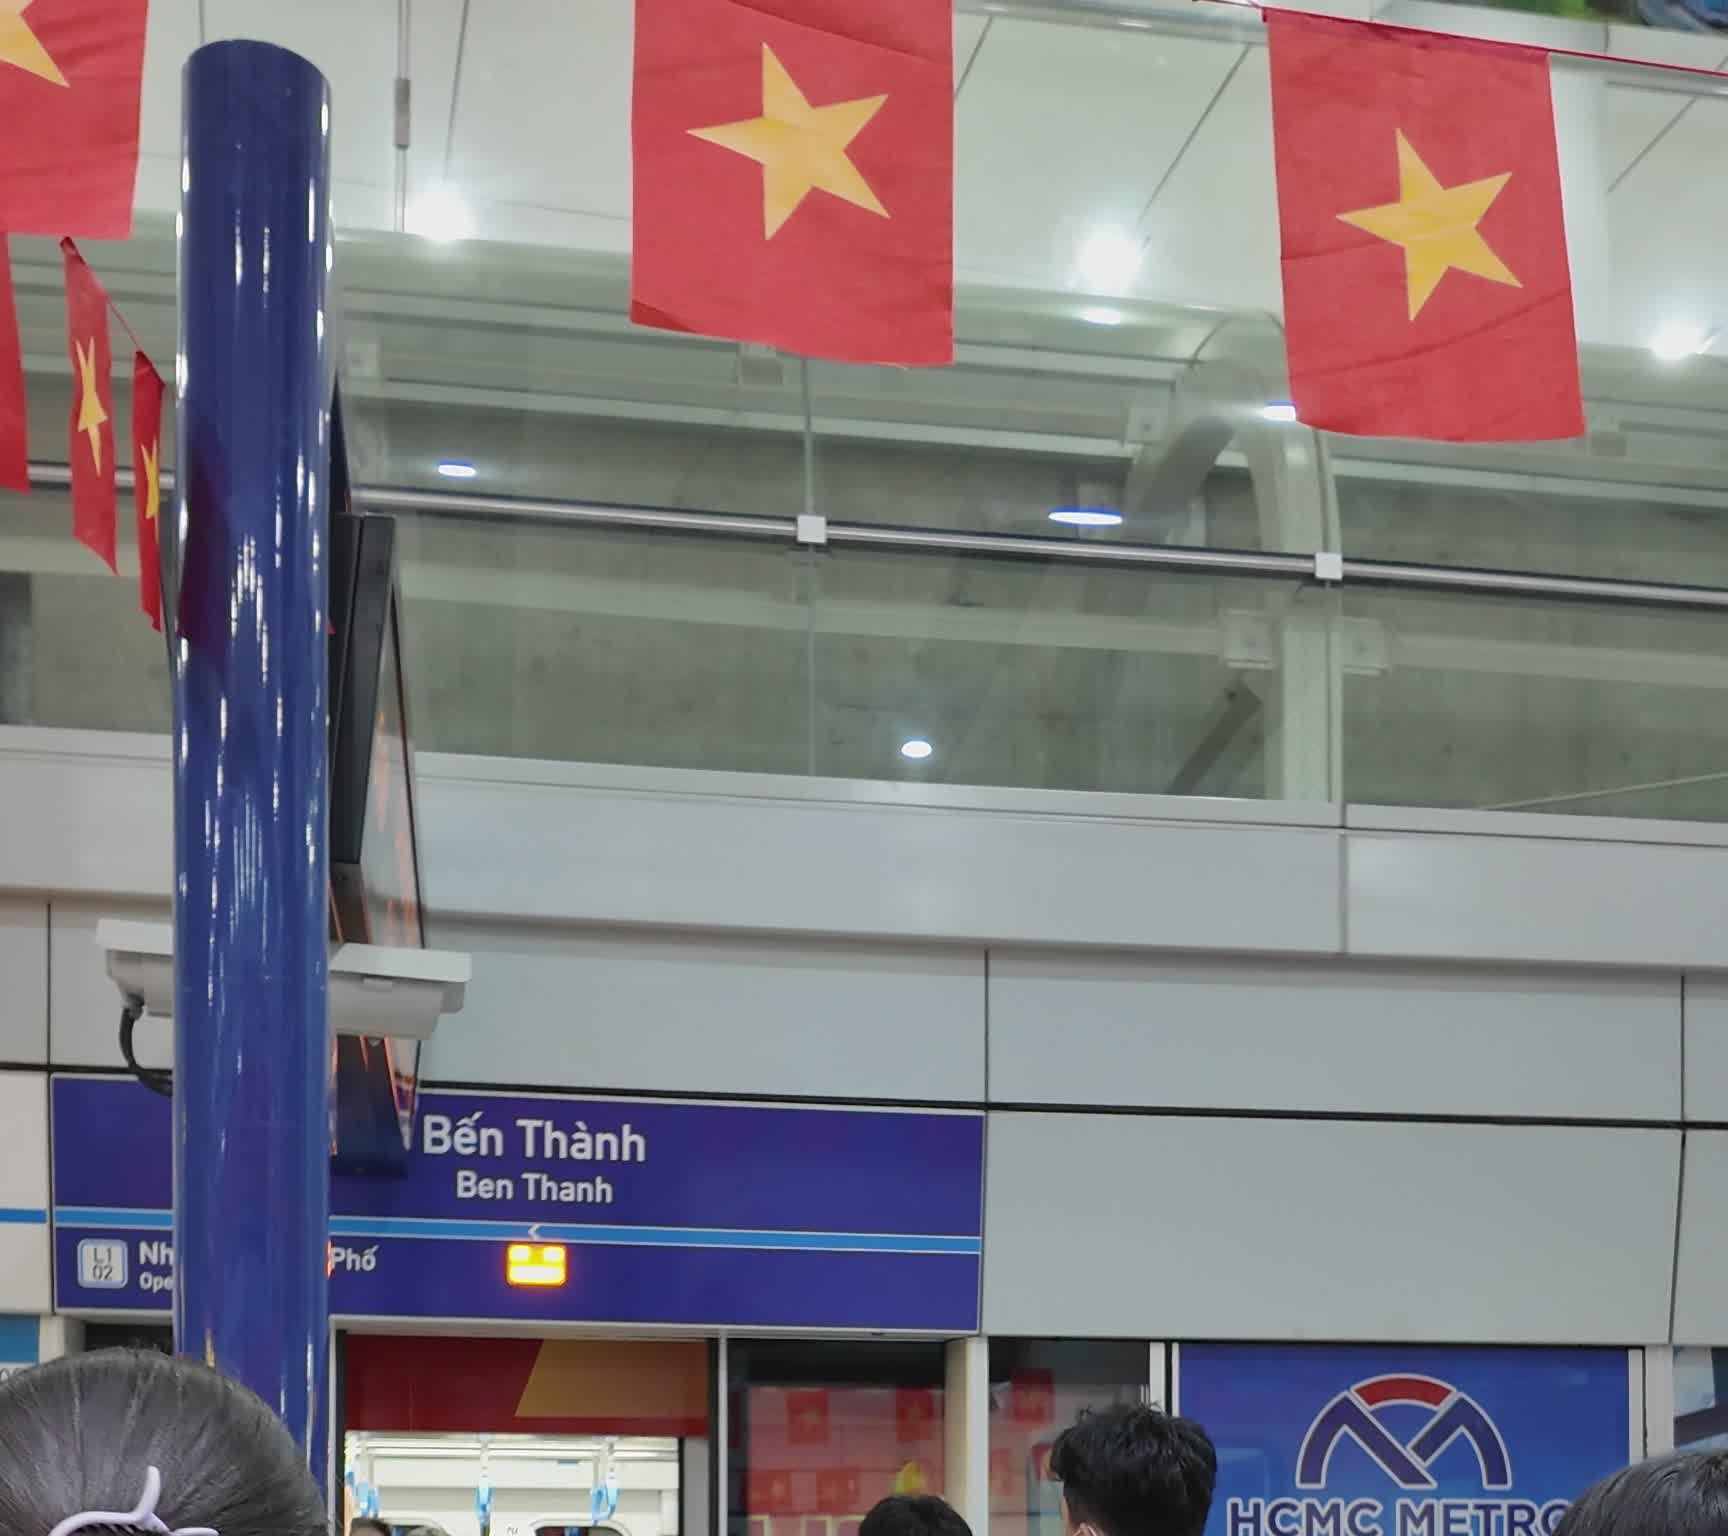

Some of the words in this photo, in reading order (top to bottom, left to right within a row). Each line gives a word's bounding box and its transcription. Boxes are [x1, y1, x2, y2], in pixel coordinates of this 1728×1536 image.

[423, 1111, 504, 1157] Bến
[516, 1119, 646, 1162] Thành
[456, 1170, 514, 1200] Ben
[521, 1172, 613, 1203] Thanh
[92, 1264, 113, 1281] 02
[331, 1244, 380, 1272] Phố
